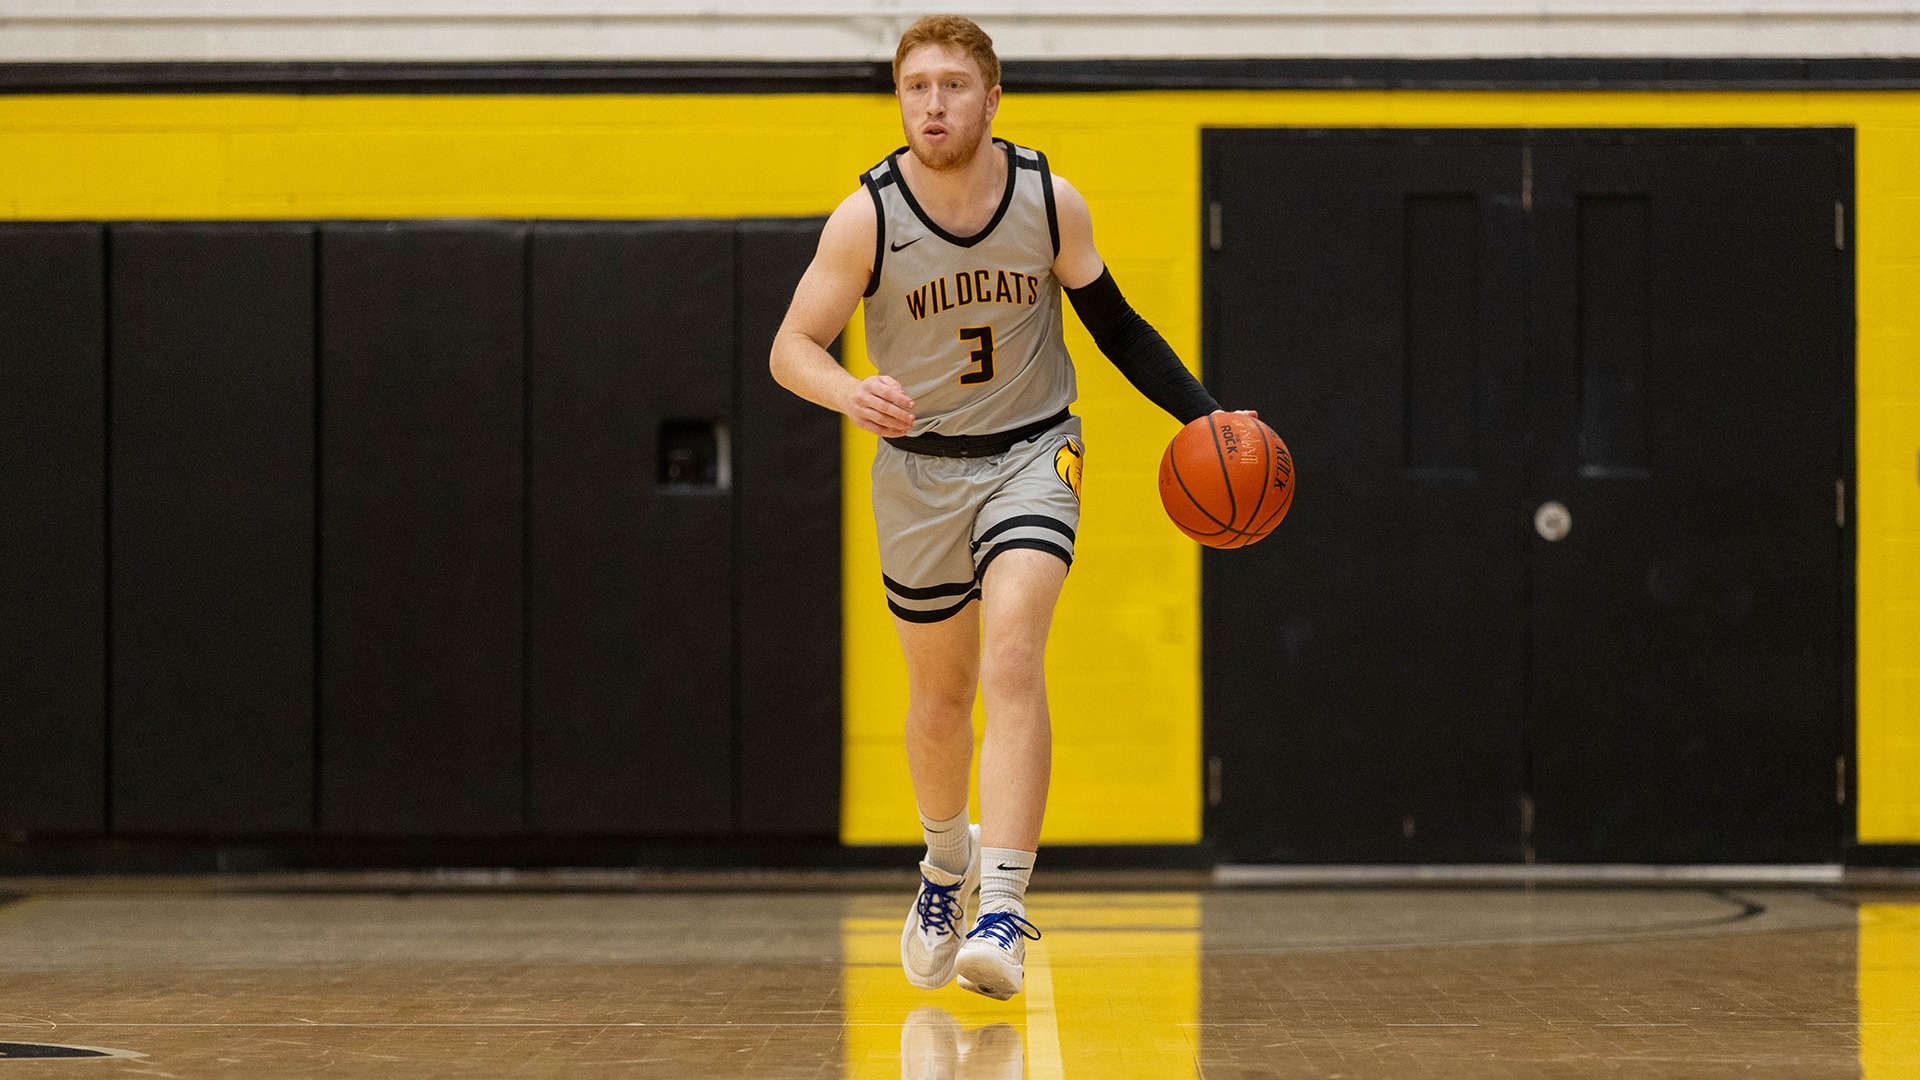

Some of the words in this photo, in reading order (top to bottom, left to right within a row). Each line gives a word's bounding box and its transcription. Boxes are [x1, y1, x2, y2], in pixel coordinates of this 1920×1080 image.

[906, 268, 1039, 321] WILDCATS
[958, 324, 996, 386] 3
[1221, 425, 1238, 454] ROCK
